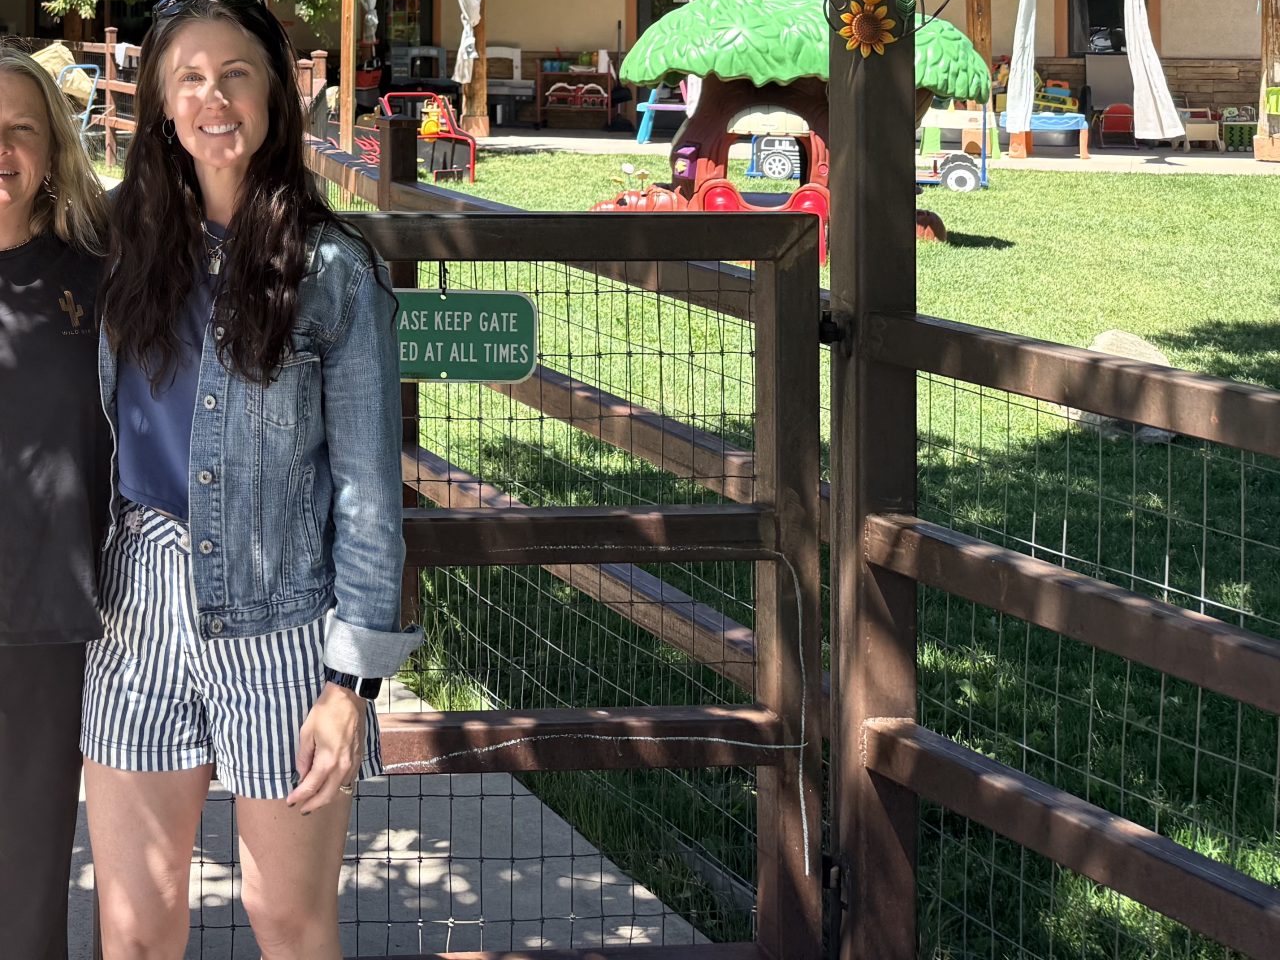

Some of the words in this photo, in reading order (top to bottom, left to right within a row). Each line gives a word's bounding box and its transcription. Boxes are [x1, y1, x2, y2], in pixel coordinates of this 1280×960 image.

[398, 310, 428, 331] ASE
[434, 311, 473, 331] KEEP
[479, 311, 518, 332] GATE
[424, 342, 444, 362] AT
[449, 342, 478, 363] ALL
[484, 343, 529, 364] TIMES
